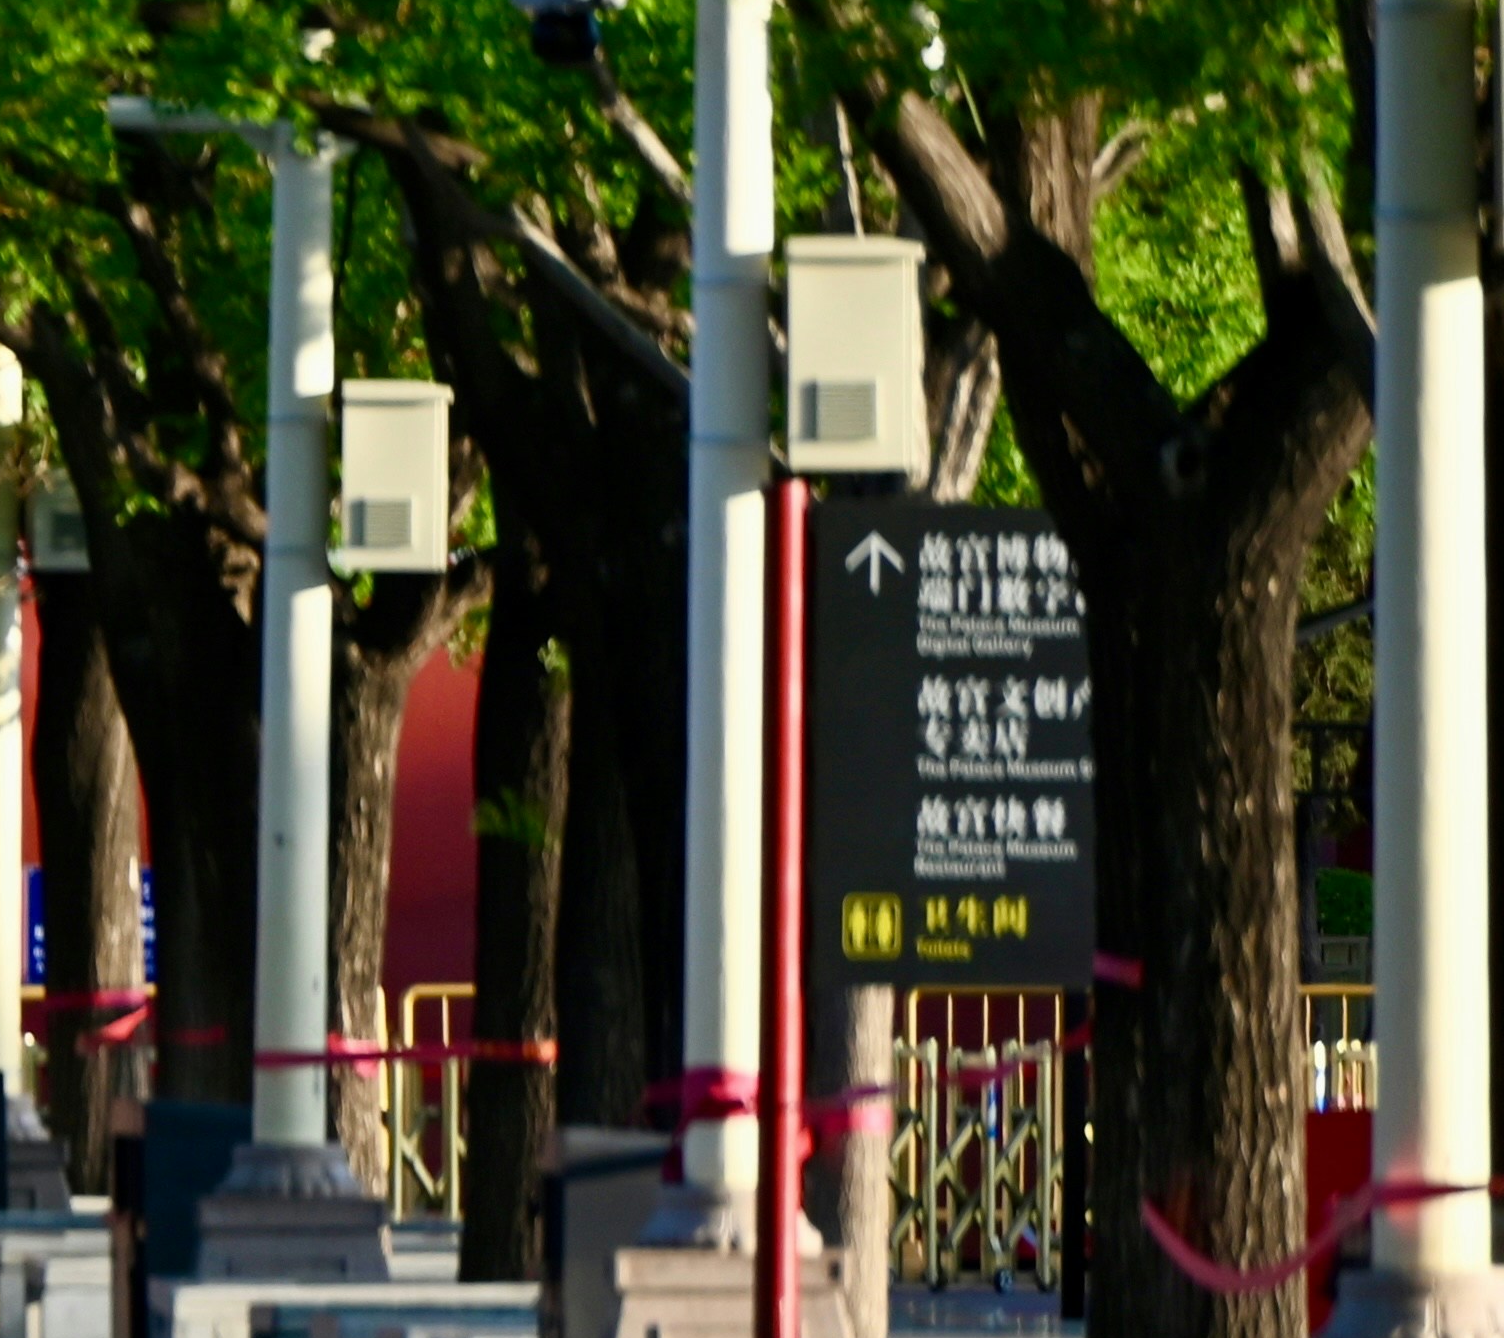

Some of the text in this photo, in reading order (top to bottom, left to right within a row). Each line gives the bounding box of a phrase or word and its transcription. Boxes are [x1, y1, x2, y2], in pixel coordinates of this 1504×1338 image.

[919, 532, 1078, 575] 故宫博物
[918, 575, 1086, 617] 端门数字
[919, 614, 1080, 640] The Palace Museum
[917, 636, 1034, 661] Digital Gallery
[917, 755, 948, 781] The
[950, 755, 1005, 781] Palace
[1007, 758, 1078, 782] Museum
[917, 839, 1078, 861] The Palace Museum
[914, 856, 1007, 881] Restaurant
[921, 894, 1029, 940] 卫生间
